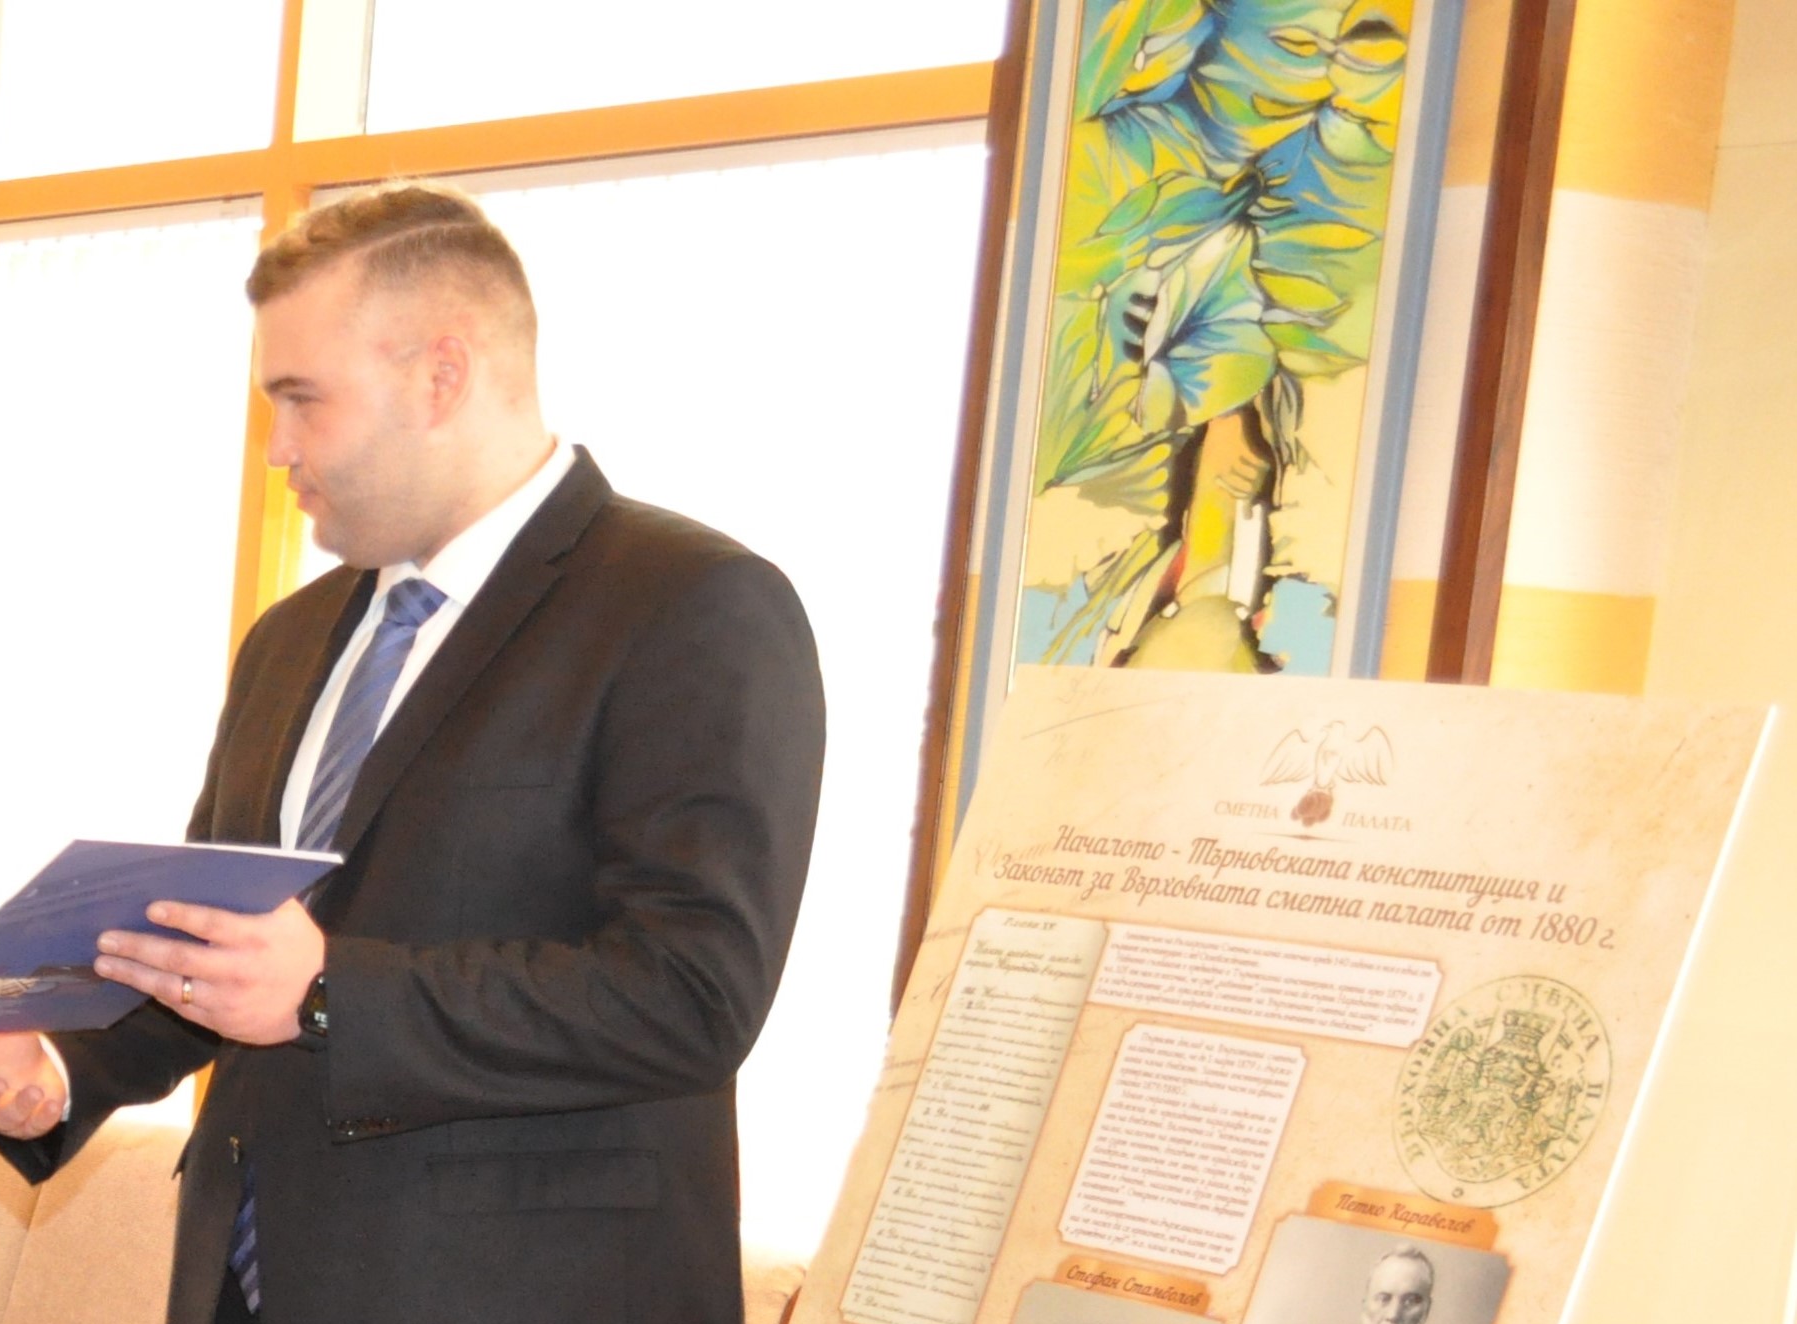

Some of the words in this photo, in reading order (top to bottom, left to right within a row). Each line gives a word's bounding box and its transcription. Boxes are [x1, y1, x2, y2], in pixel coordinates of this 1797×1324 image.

[1214, 800, 1279, 819] СМЕТНА
[1342, 812, 1412, 831] ПАЛАТА
[1055, 824, 1166, 861] Началото
[1187, 837, 1353, 880] Търновската
[1356, 863, 1540, 907] конституция
[1547, 883, 1567, 904] и
[993, 850, 1085, 887] Законът
[1080, 870, 1114, 902] за
[1123, 867, 1261, 907] Върховната
[1265, 890, 1364, 919] сметна
[1369, 901, 1474, 932] палата
[1480, 914, 1523, 938] от
[1530, 912, 1598, 946] 1880
[1598, 928, 1615, 950] г.
[1335, 1194, 1384, 1217] Петко
[1389, 1203, 1476, 1234] Каравелов
[1066, 1264, 1121, 1290] Стефан
[1123, 1277, 1204, 1306] Стамболов
